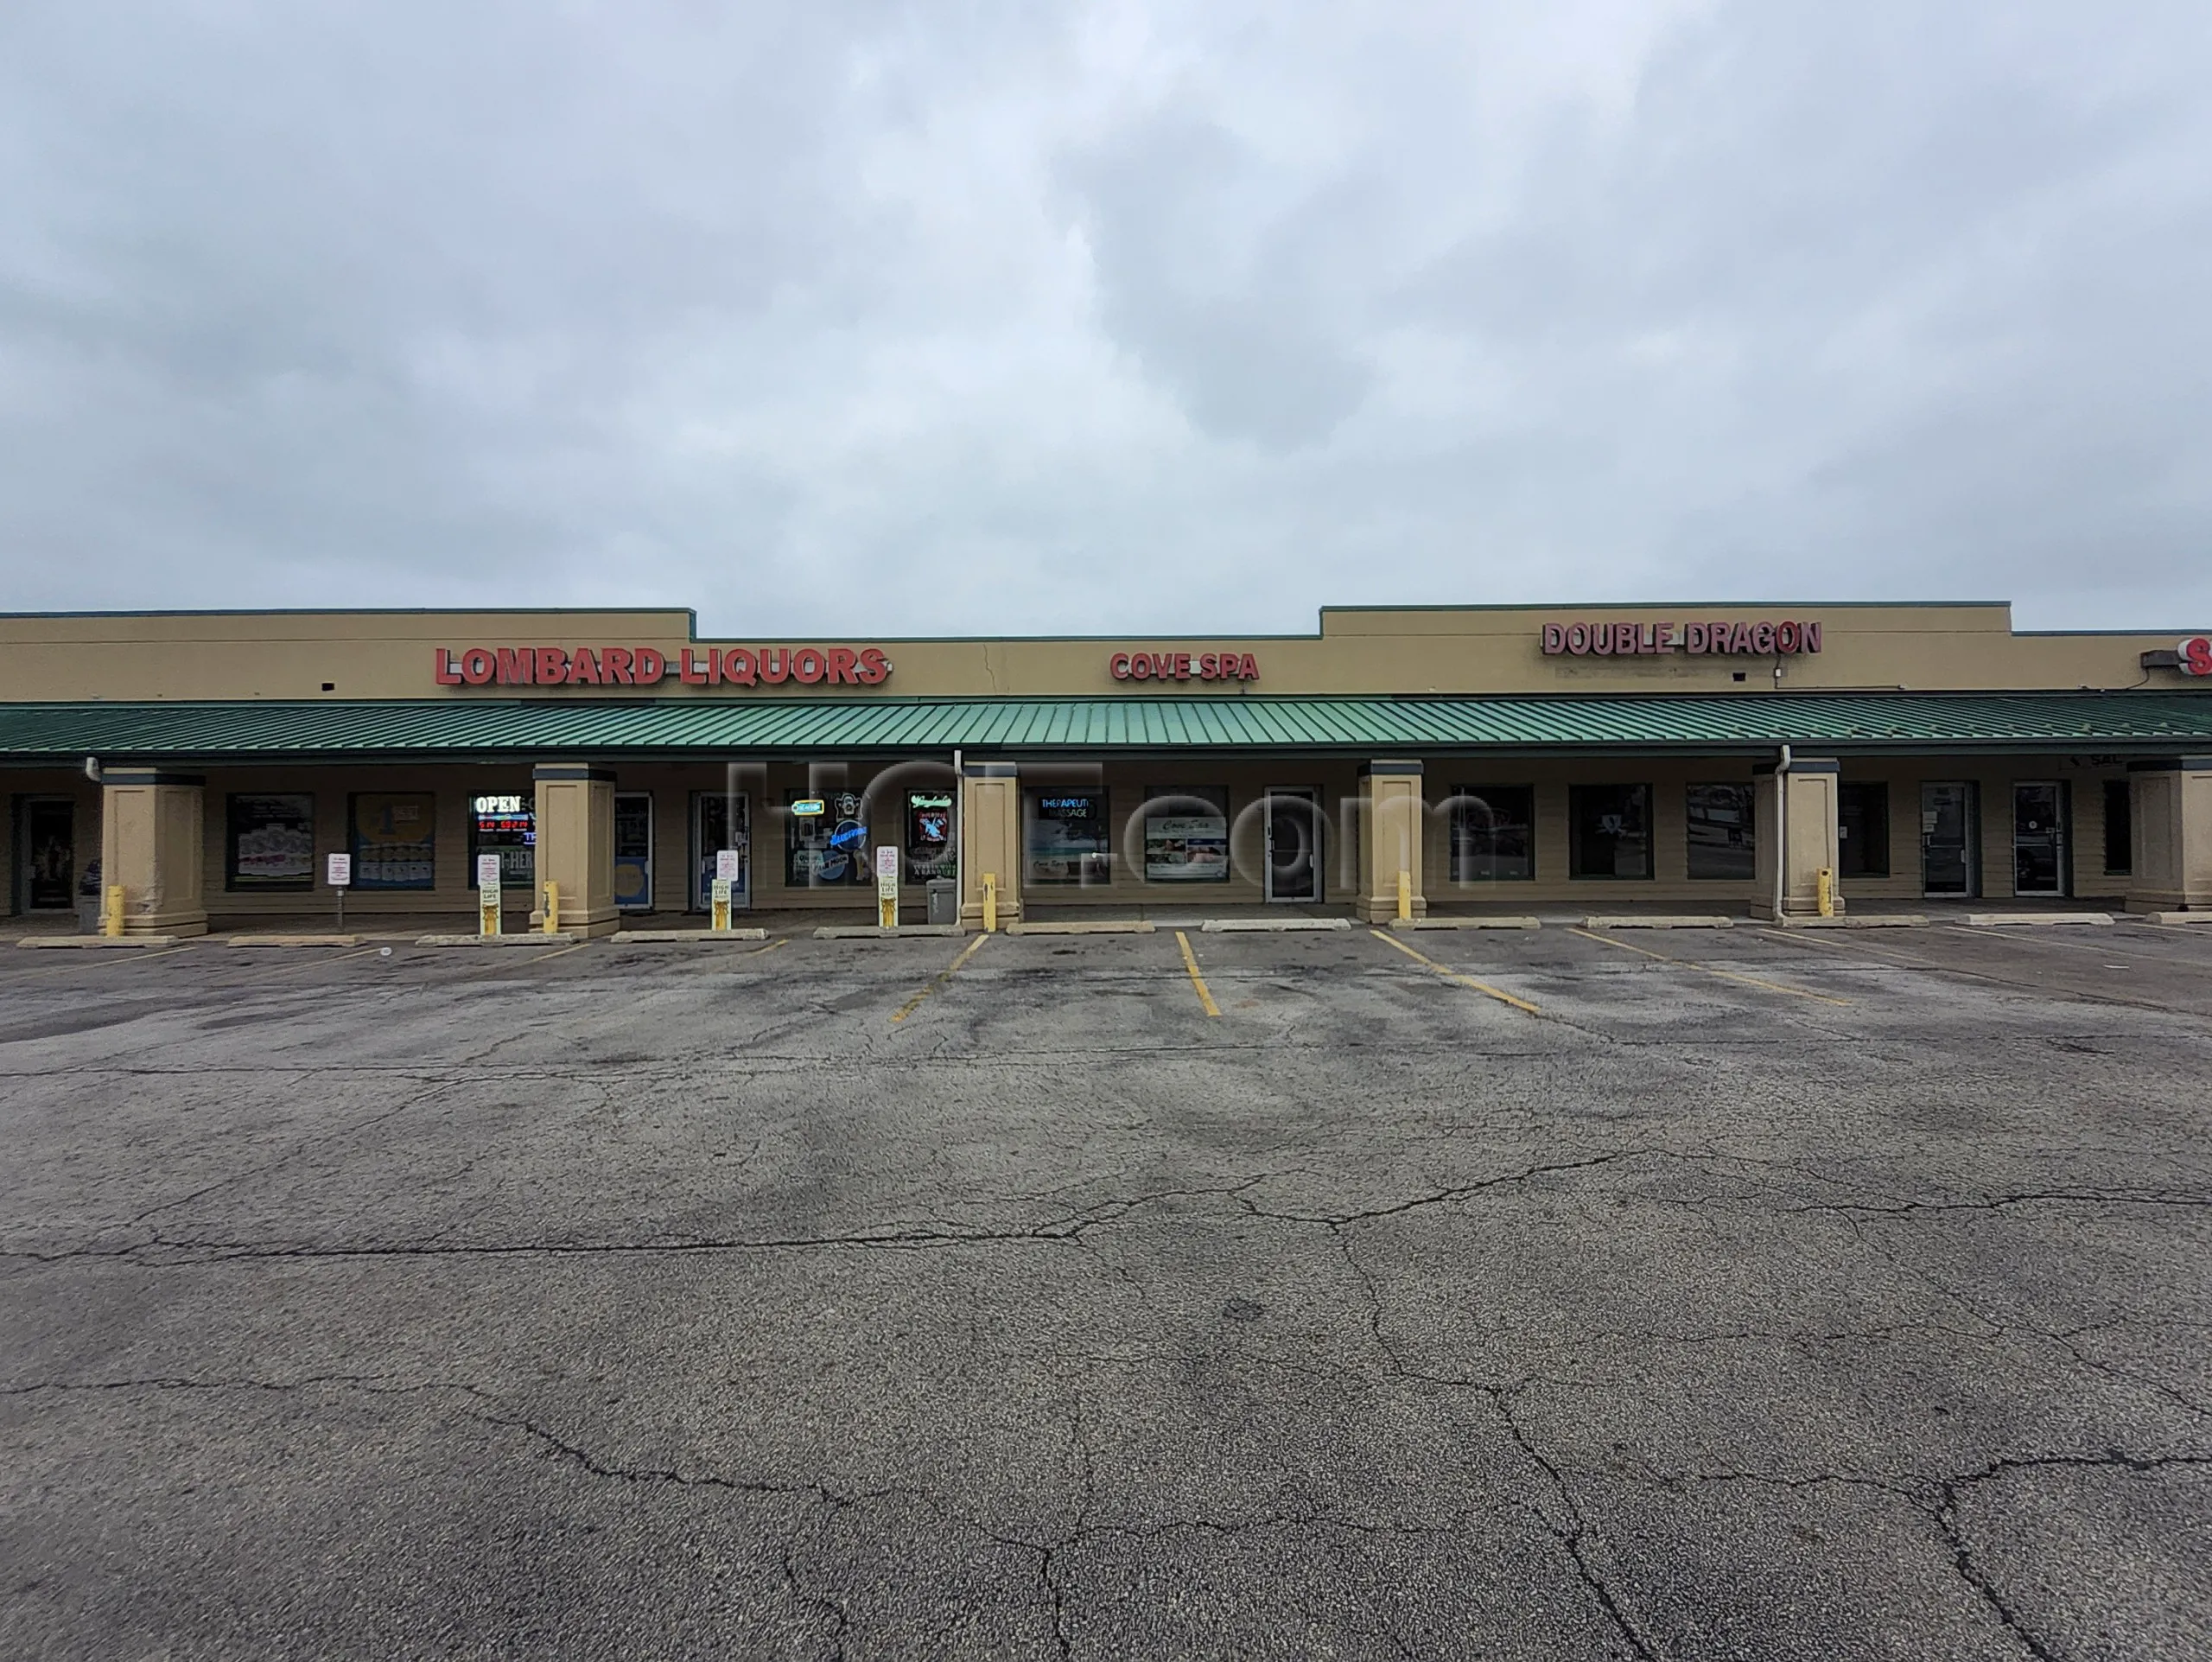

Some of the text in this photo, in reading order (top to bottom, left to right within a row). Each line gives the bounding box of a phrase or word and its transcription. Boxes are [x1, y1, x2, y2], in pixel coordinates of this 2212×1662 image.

[1542, 621, 1821, 655] DOUBLE DRAGON
[435, 647, 889, 687] LOMBARD LIQUORS
[1109, 653, 1260, 680] COVE SPA
[476, 796, 521, 813] OPEN
